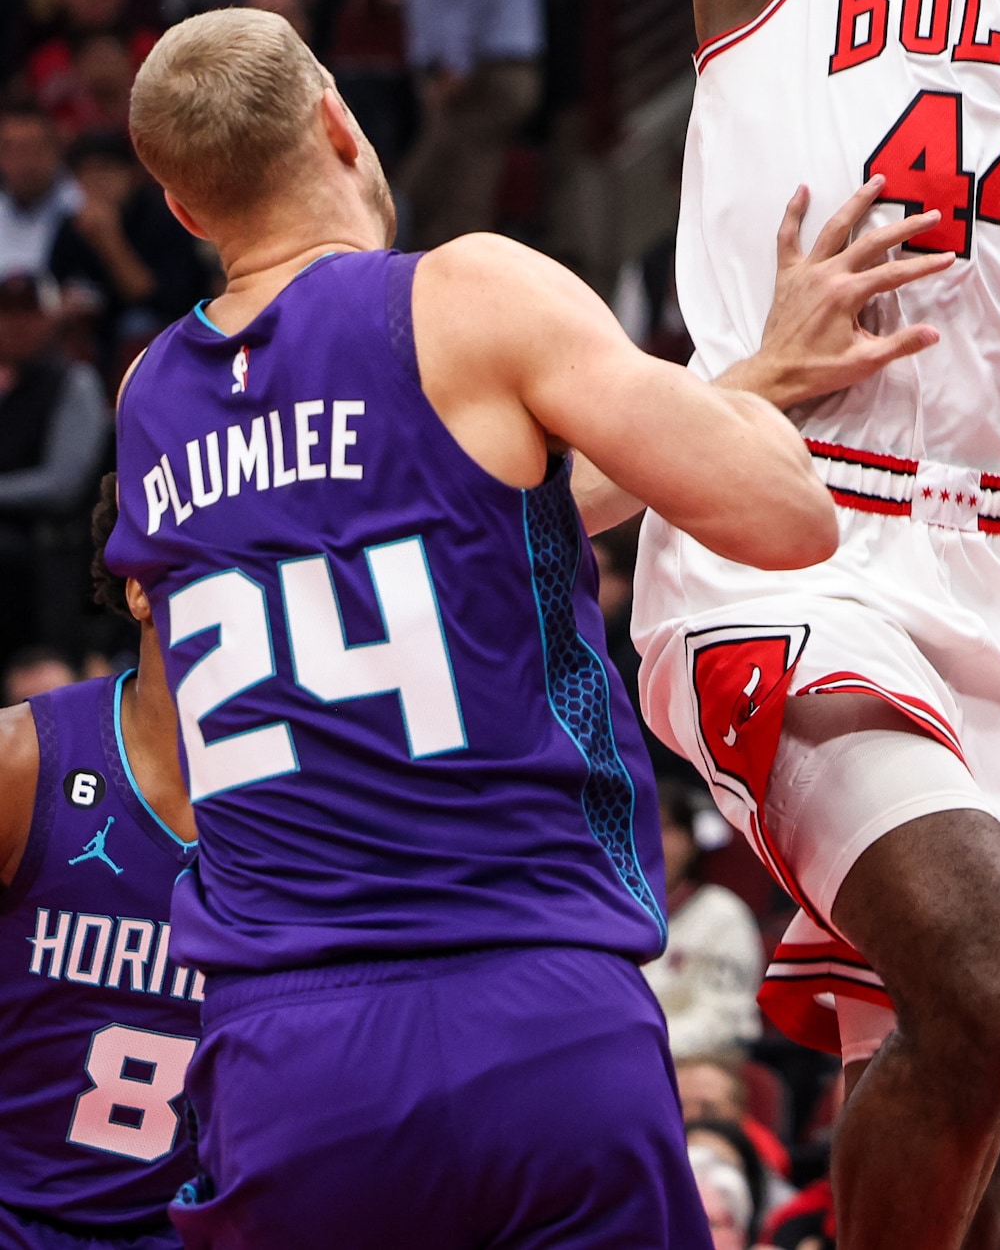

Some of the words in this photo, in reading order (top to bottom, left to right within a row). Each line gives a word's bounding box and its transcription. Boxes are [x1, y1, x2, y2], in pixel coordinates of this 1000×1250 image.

[142, 399, 366, 537] PLUMLEE
[167, 534, 469, 805] 24
[71, 772, 98, 805] 6
[26, 907, 206, 1003] HORN
[66, 1022, 200, 1164] 8
